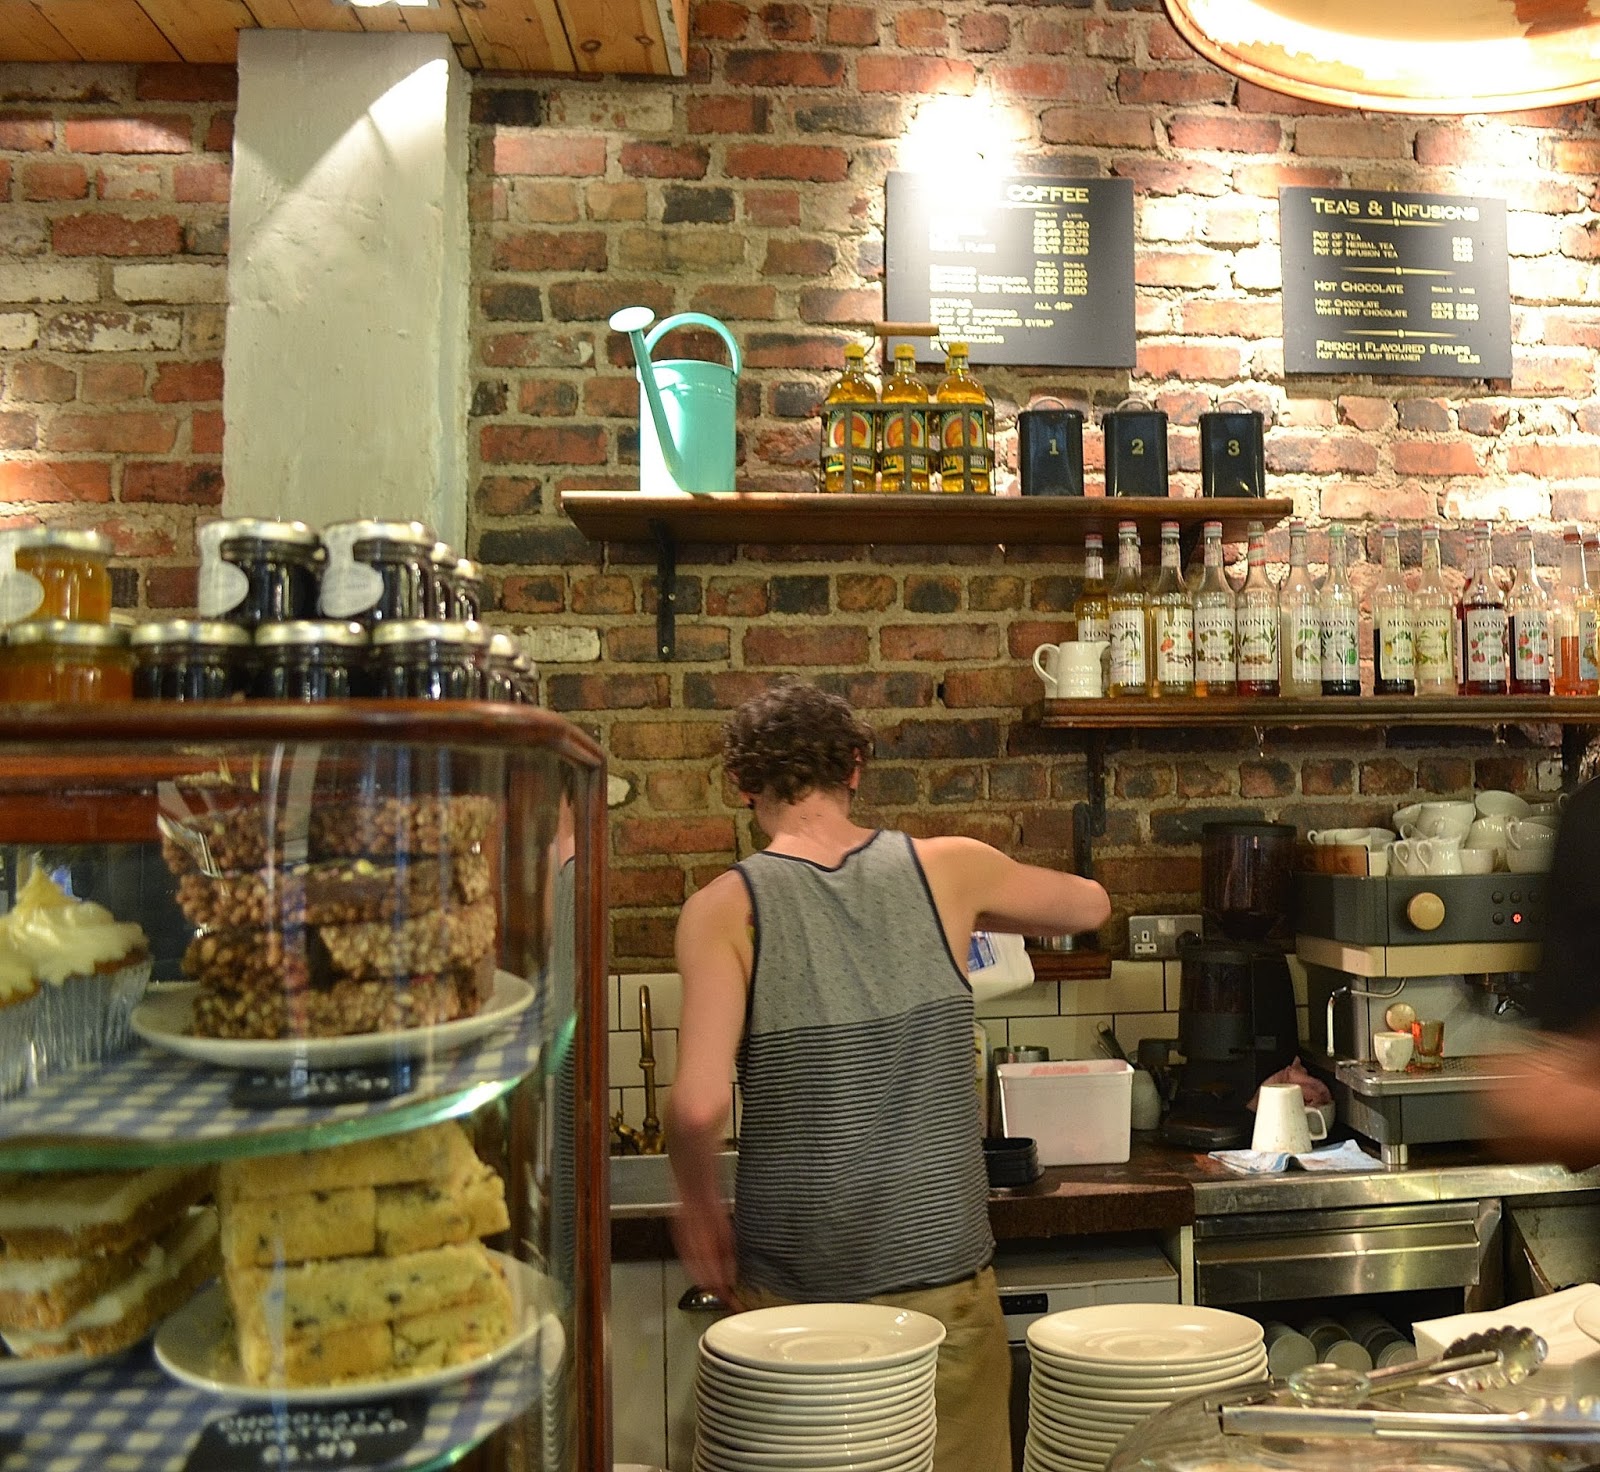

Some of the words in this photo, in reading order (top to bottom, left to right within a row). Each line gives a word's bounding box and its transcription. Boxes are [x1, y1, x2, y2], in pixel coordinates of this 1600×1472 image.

[1007, 185, 1089, 203] COFFEE
[1311, 197, 1360, 215] TEA'S
[1368, 200, 1383, 216] &
[1393, 201, 1480, 221] INFUSIONS
[1345, 231, 1361, 240] TEA
[1379, 242, 1394, 250] TEA
[1346, 248, 1380, 257] INFUSION
[1383, 250, 1398, 258] TEA
[1314, 280, 1337, 291] HOT
[1341, 281, 1404, 294] CHOCOLATE
[1315, 298, 1332, 307] HOT
[1334, 298, 1379, 308] CHOCOLATE
[1315, 306, 1341, 315] WHITE
[1344, 307, 1360, 316] HOT
[1363, 308, 1408, 318] CHOCOLATE
[1316, 340, 1360, 351] FRENCH
[1364, 341, 1425, 354] FLAVOURED
[1430, 343, 1470, 355] SYRUPS
[1316, 350, 1333, 359] HOT
[1336, 351, 1355, 359] MILK
[1357, 351, 1382, 360] SYRUP
[1386, 352, 1420, 361] STEAMER
[1049, 439, 1059, 455] 1
[1131, 438, 1144, 455] 2
[1227, 440, 1240, 456] 3
[1110, 620, 1137, 629] ONIN
[1163, 620, 1192, 628] MONI
[1198, 620, 1233, 628] MONIN
[1238, 618, 1273, 627] MONIN
[1321, 619, 1356, 627] MONIN
[1387, 619, 1411, 627] MON
[1522, 620, 1545, 628] MON
